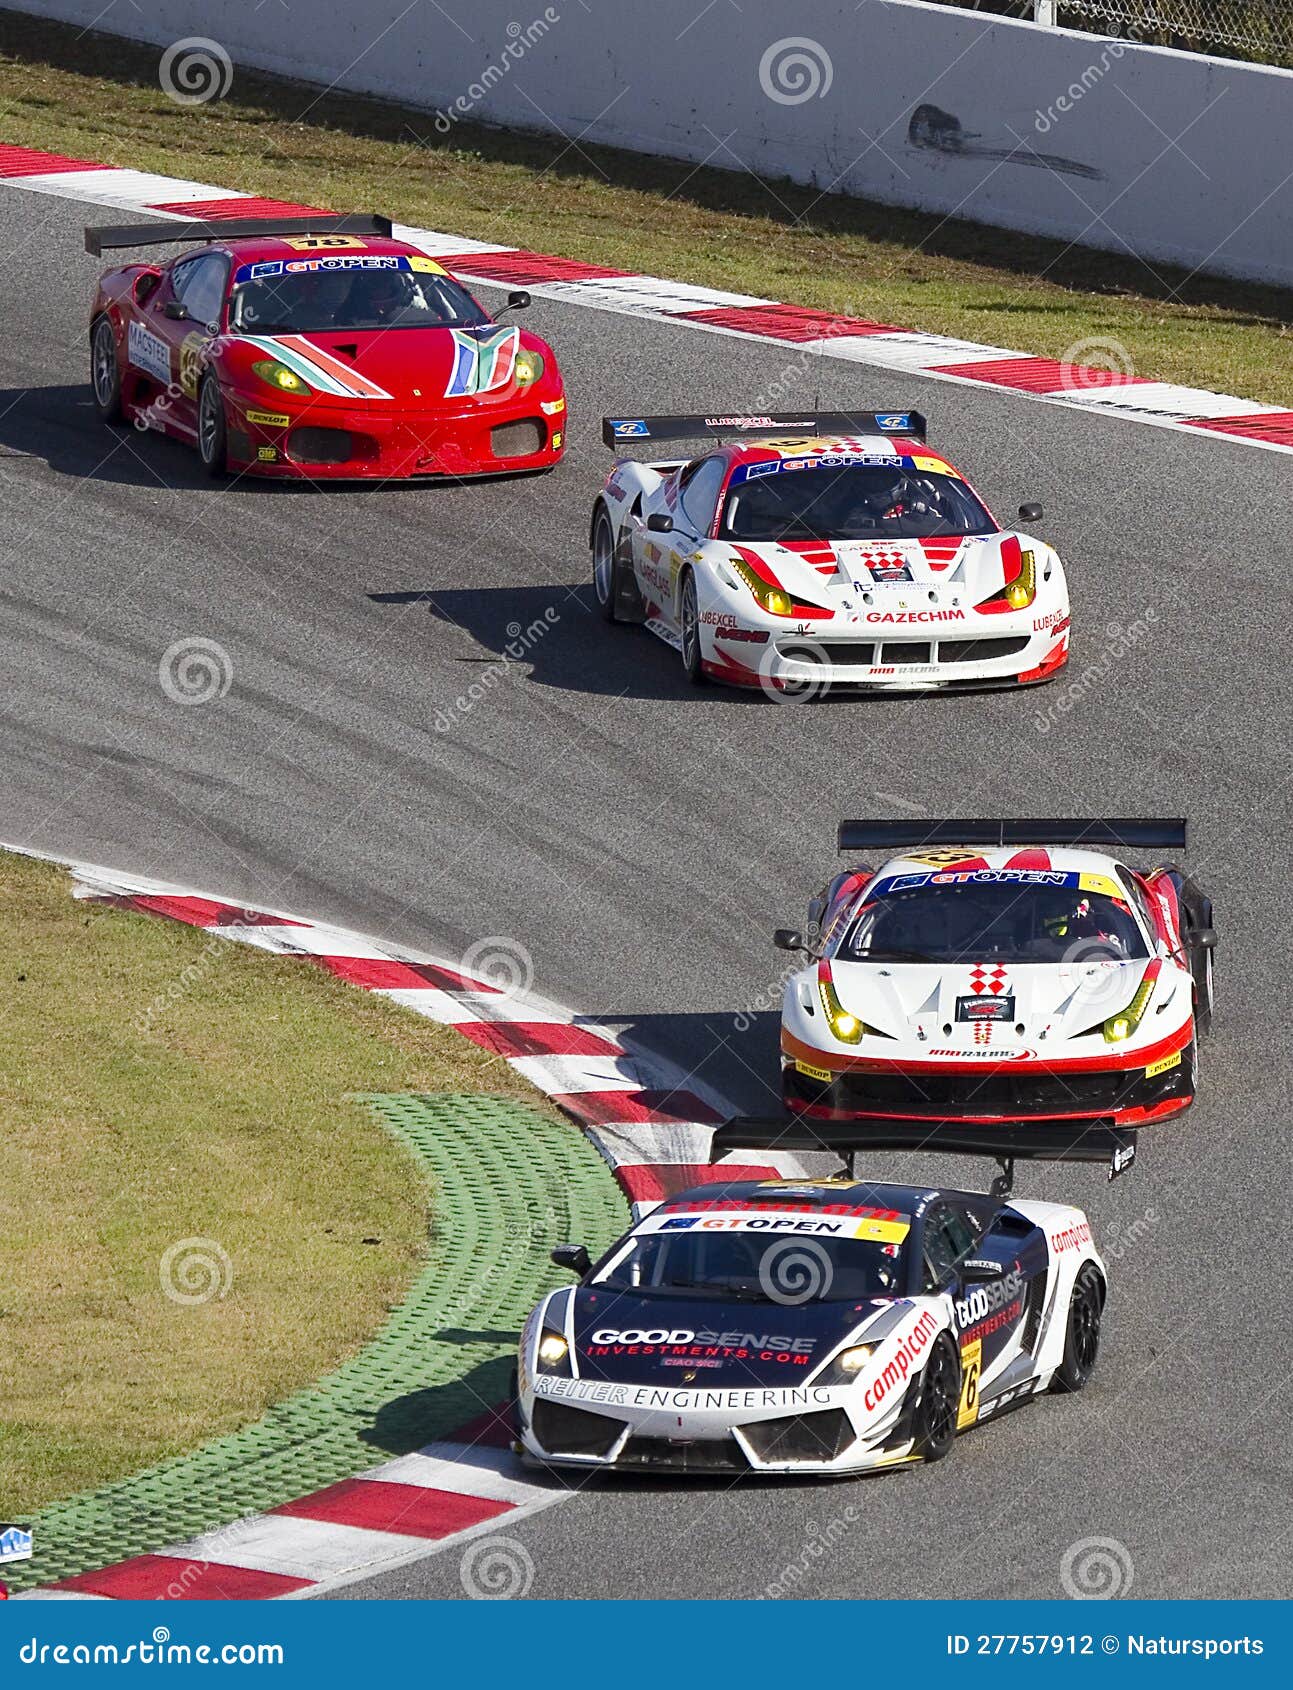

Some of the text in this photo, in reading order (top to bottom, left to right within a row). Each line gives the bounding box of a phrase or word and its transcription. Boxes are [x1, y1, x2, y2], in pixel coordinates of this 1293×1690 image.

[299, 239, 350, 247] 18
[253, 414, 287, 423] DUNLOP
[866, 610, 966, 623] GAZECHIM
[801, 1064, 829, 1078] DUNLOP
[1153, 1055, 1180, 1073] DUNLOP
[587, 1346, 809, 1366] INVESTMENTS.COM
[664, 1358, 693, 1367] CIAO
[864, 1311, 938, 1412] campicarn
[534, 1376, 831, 1409] REITER ENGINEERING
